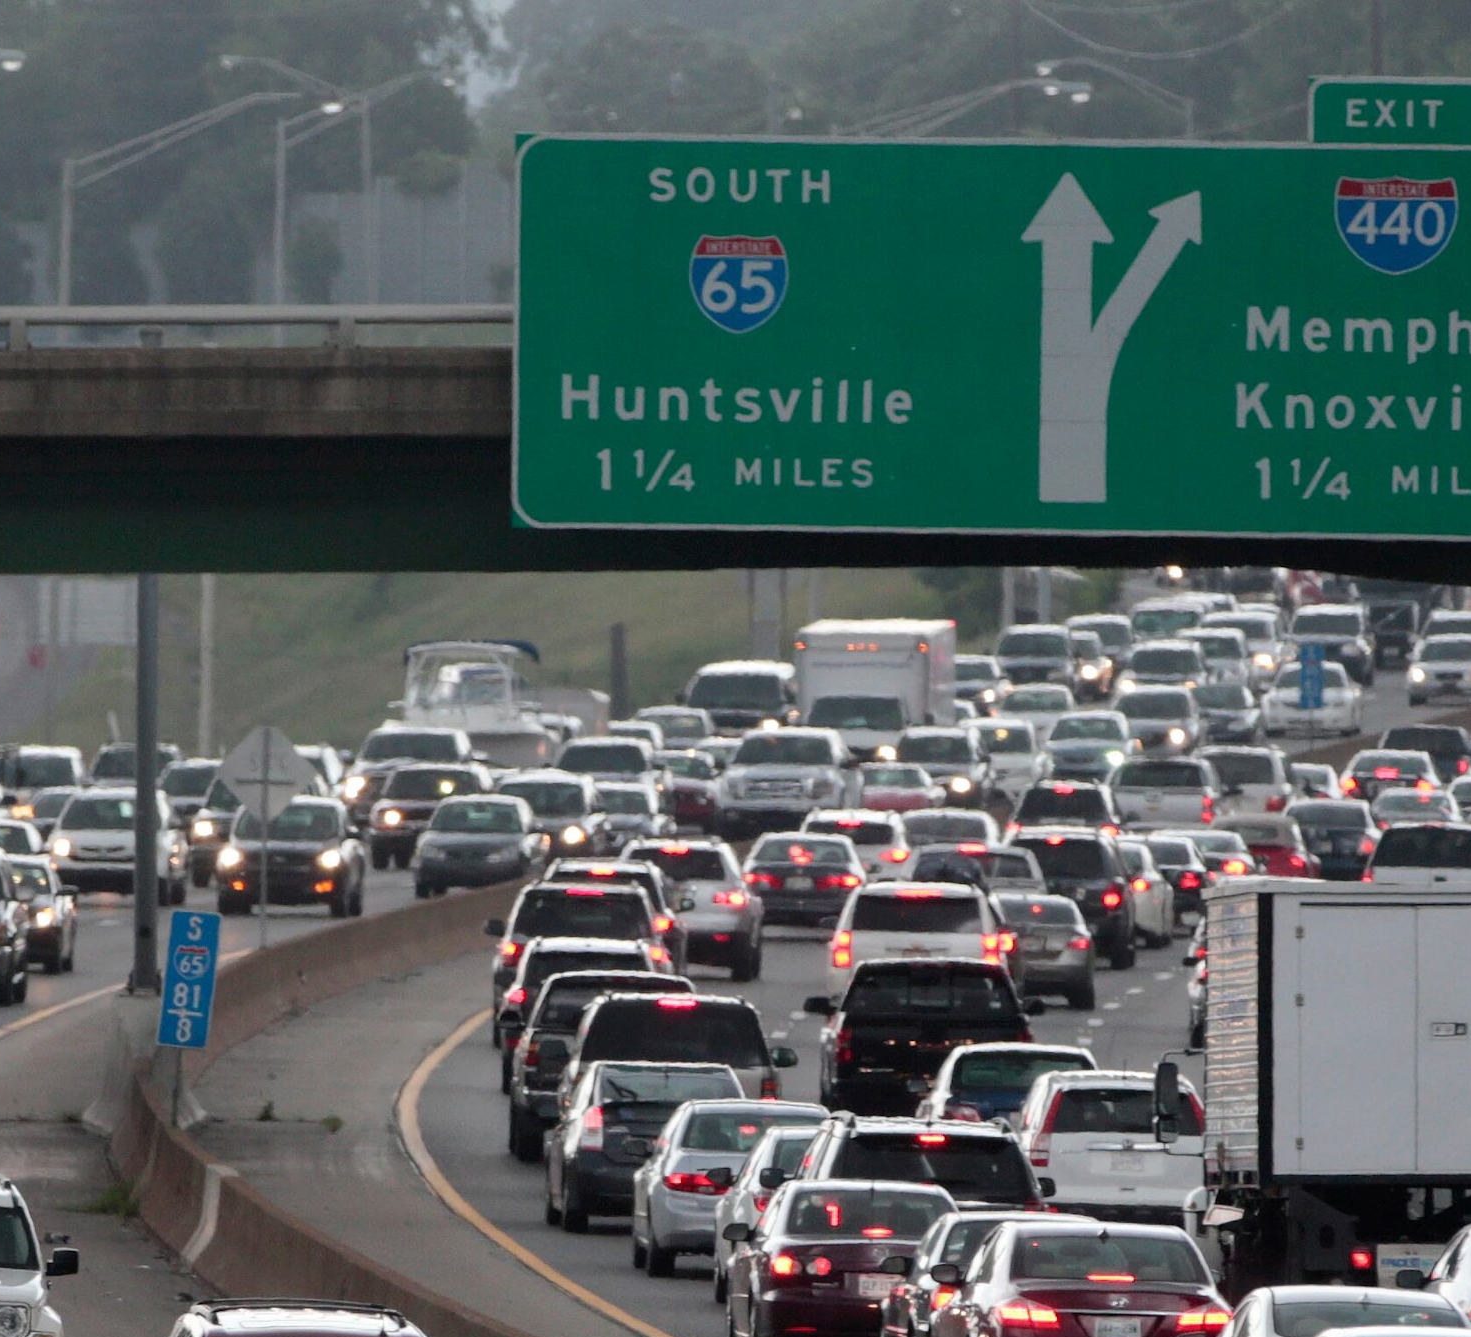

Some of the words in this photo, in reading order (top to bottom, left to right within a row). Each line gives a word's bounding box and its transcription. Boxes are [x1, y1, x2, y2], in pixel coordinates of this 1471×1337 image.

[1345, 98, 1444, 129] EXIT
[648, 167, 831, 204] SOUTH
[1362, 183, 1430, 196] INTERSTATE
[1346, 202, 1446, 246] 440
[702, 261, 775, 314] 65
[561, 373, 913, 425] Huntsville
[734, 457, 874, 488] MILES
[186, 916, 203, 941] S
[179, 955, 205, 975] 65
[173, 982, 201, 1009] 81
[175, 1018, 192, 1043] 8
